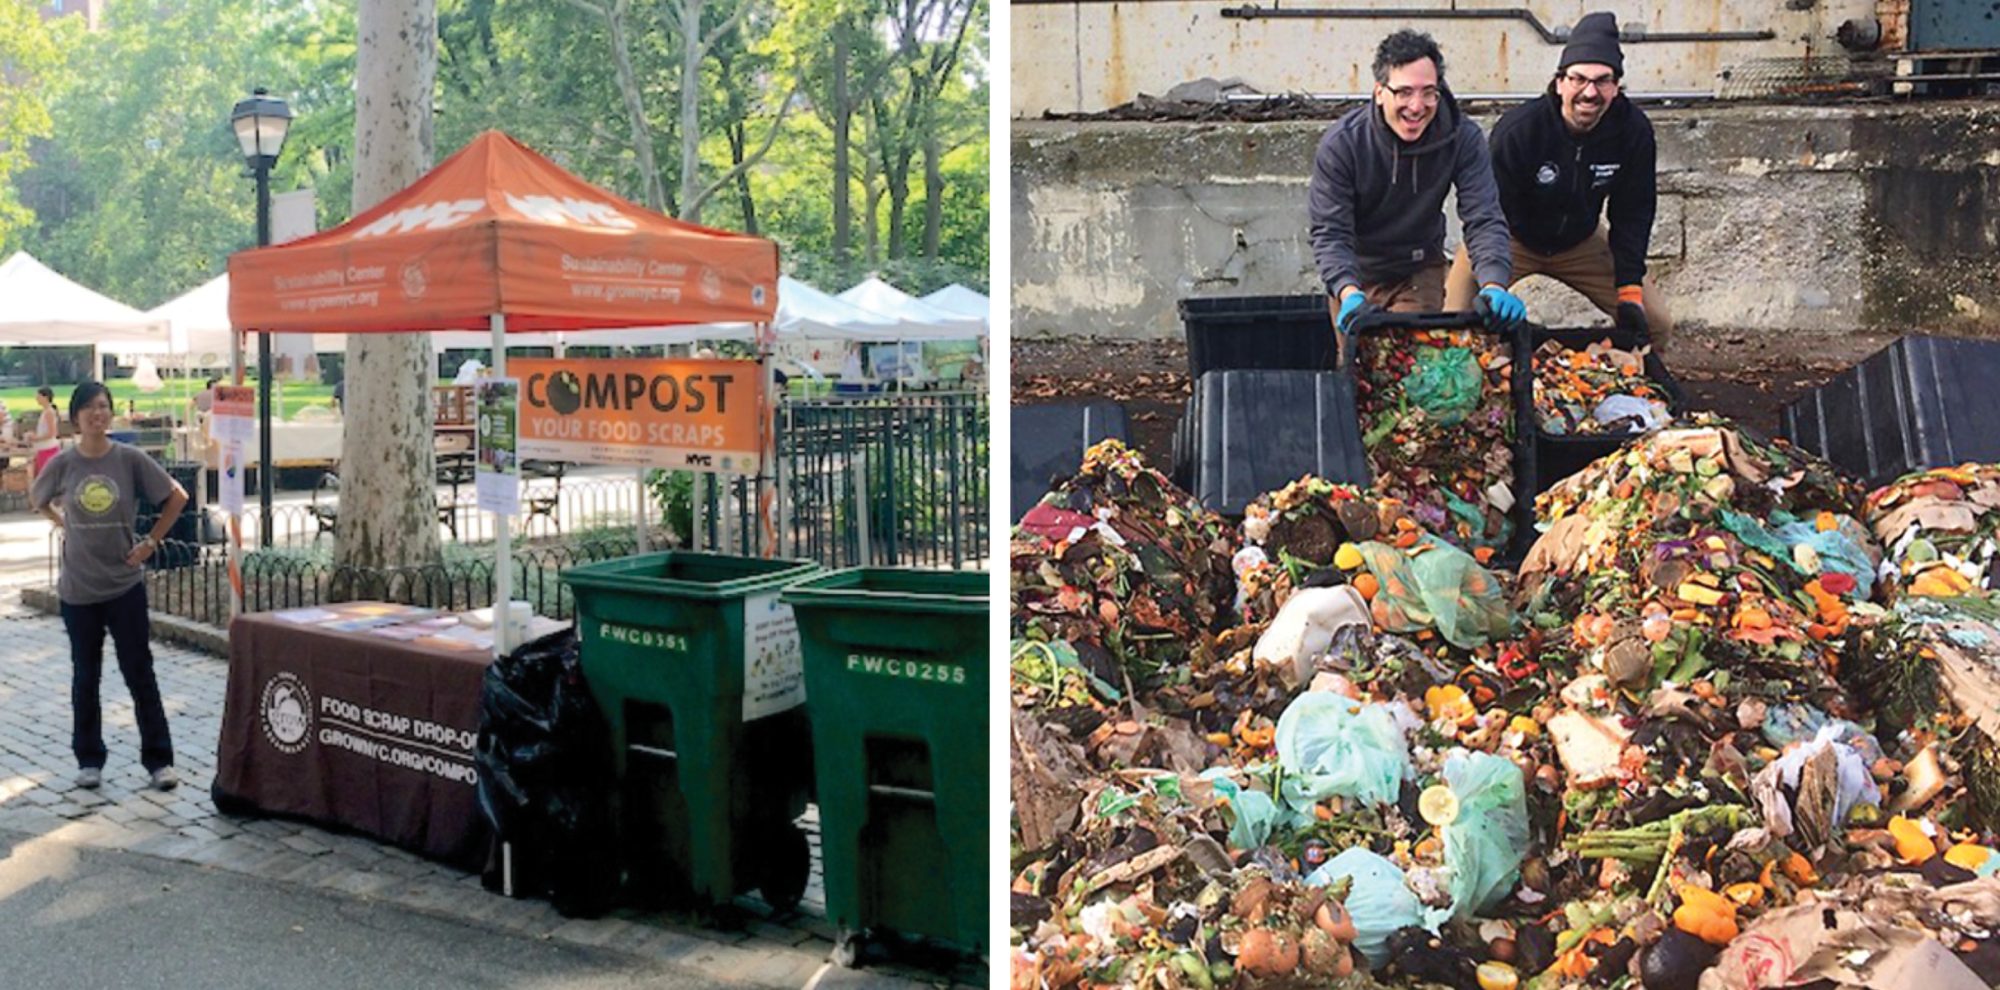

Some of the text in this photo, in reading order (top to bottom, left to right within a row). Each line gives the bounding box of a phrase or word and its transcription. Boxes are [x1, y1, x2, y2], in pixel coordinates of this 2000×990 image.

[347, 266, 386, 281] Center
[561, 254, 688, 277] Sustainability Center
[571, 283, 681, 304] www.grownyc.org
[527, 370, 733, 415] COMPOST
[532, 417, 582, 438] YOUR
[589, 420, 641, 442] FOOD
[647, 422, 725, 447] SCRAPS
[847, 654, 966, 684] FWC0255
[321, 697, 360, 721] FOOD
[363, 708, 411, 734] SCRAP
